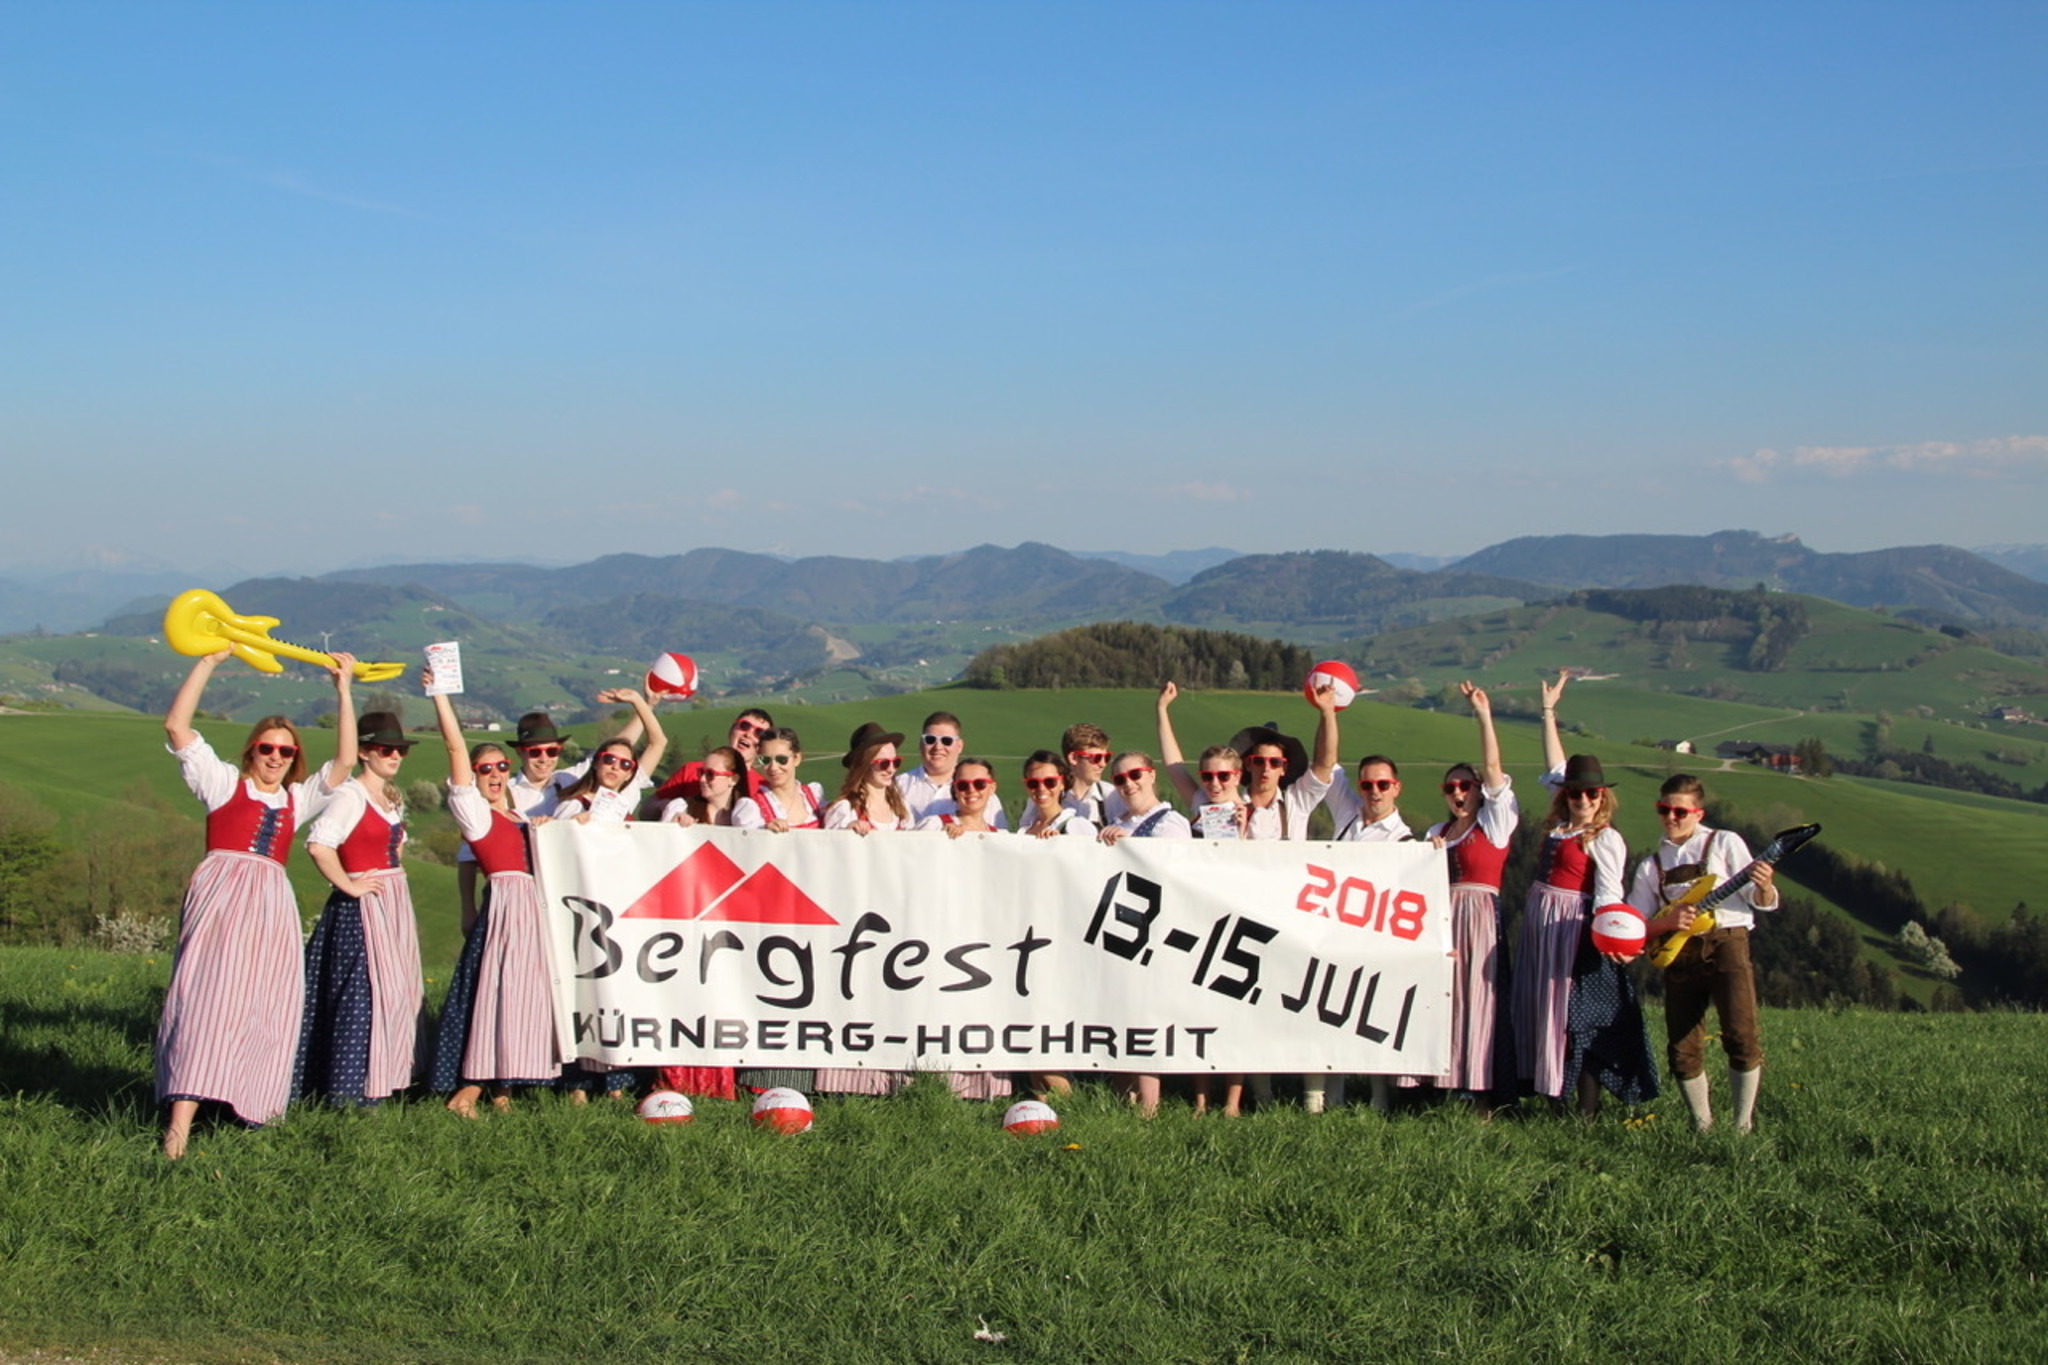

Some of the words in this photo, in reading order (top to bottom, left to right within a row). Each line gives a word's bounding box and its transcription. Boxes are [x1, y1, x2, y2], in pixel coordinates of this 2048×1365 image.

[1296, 863, 1427, 941] 2018
[561, 895, 1052, 1009] Bergfest
[573, 1008, 1218, 1059] KÜRNBERG-HOCHREIT
[1281, 957, 1417, 1052] JULI
